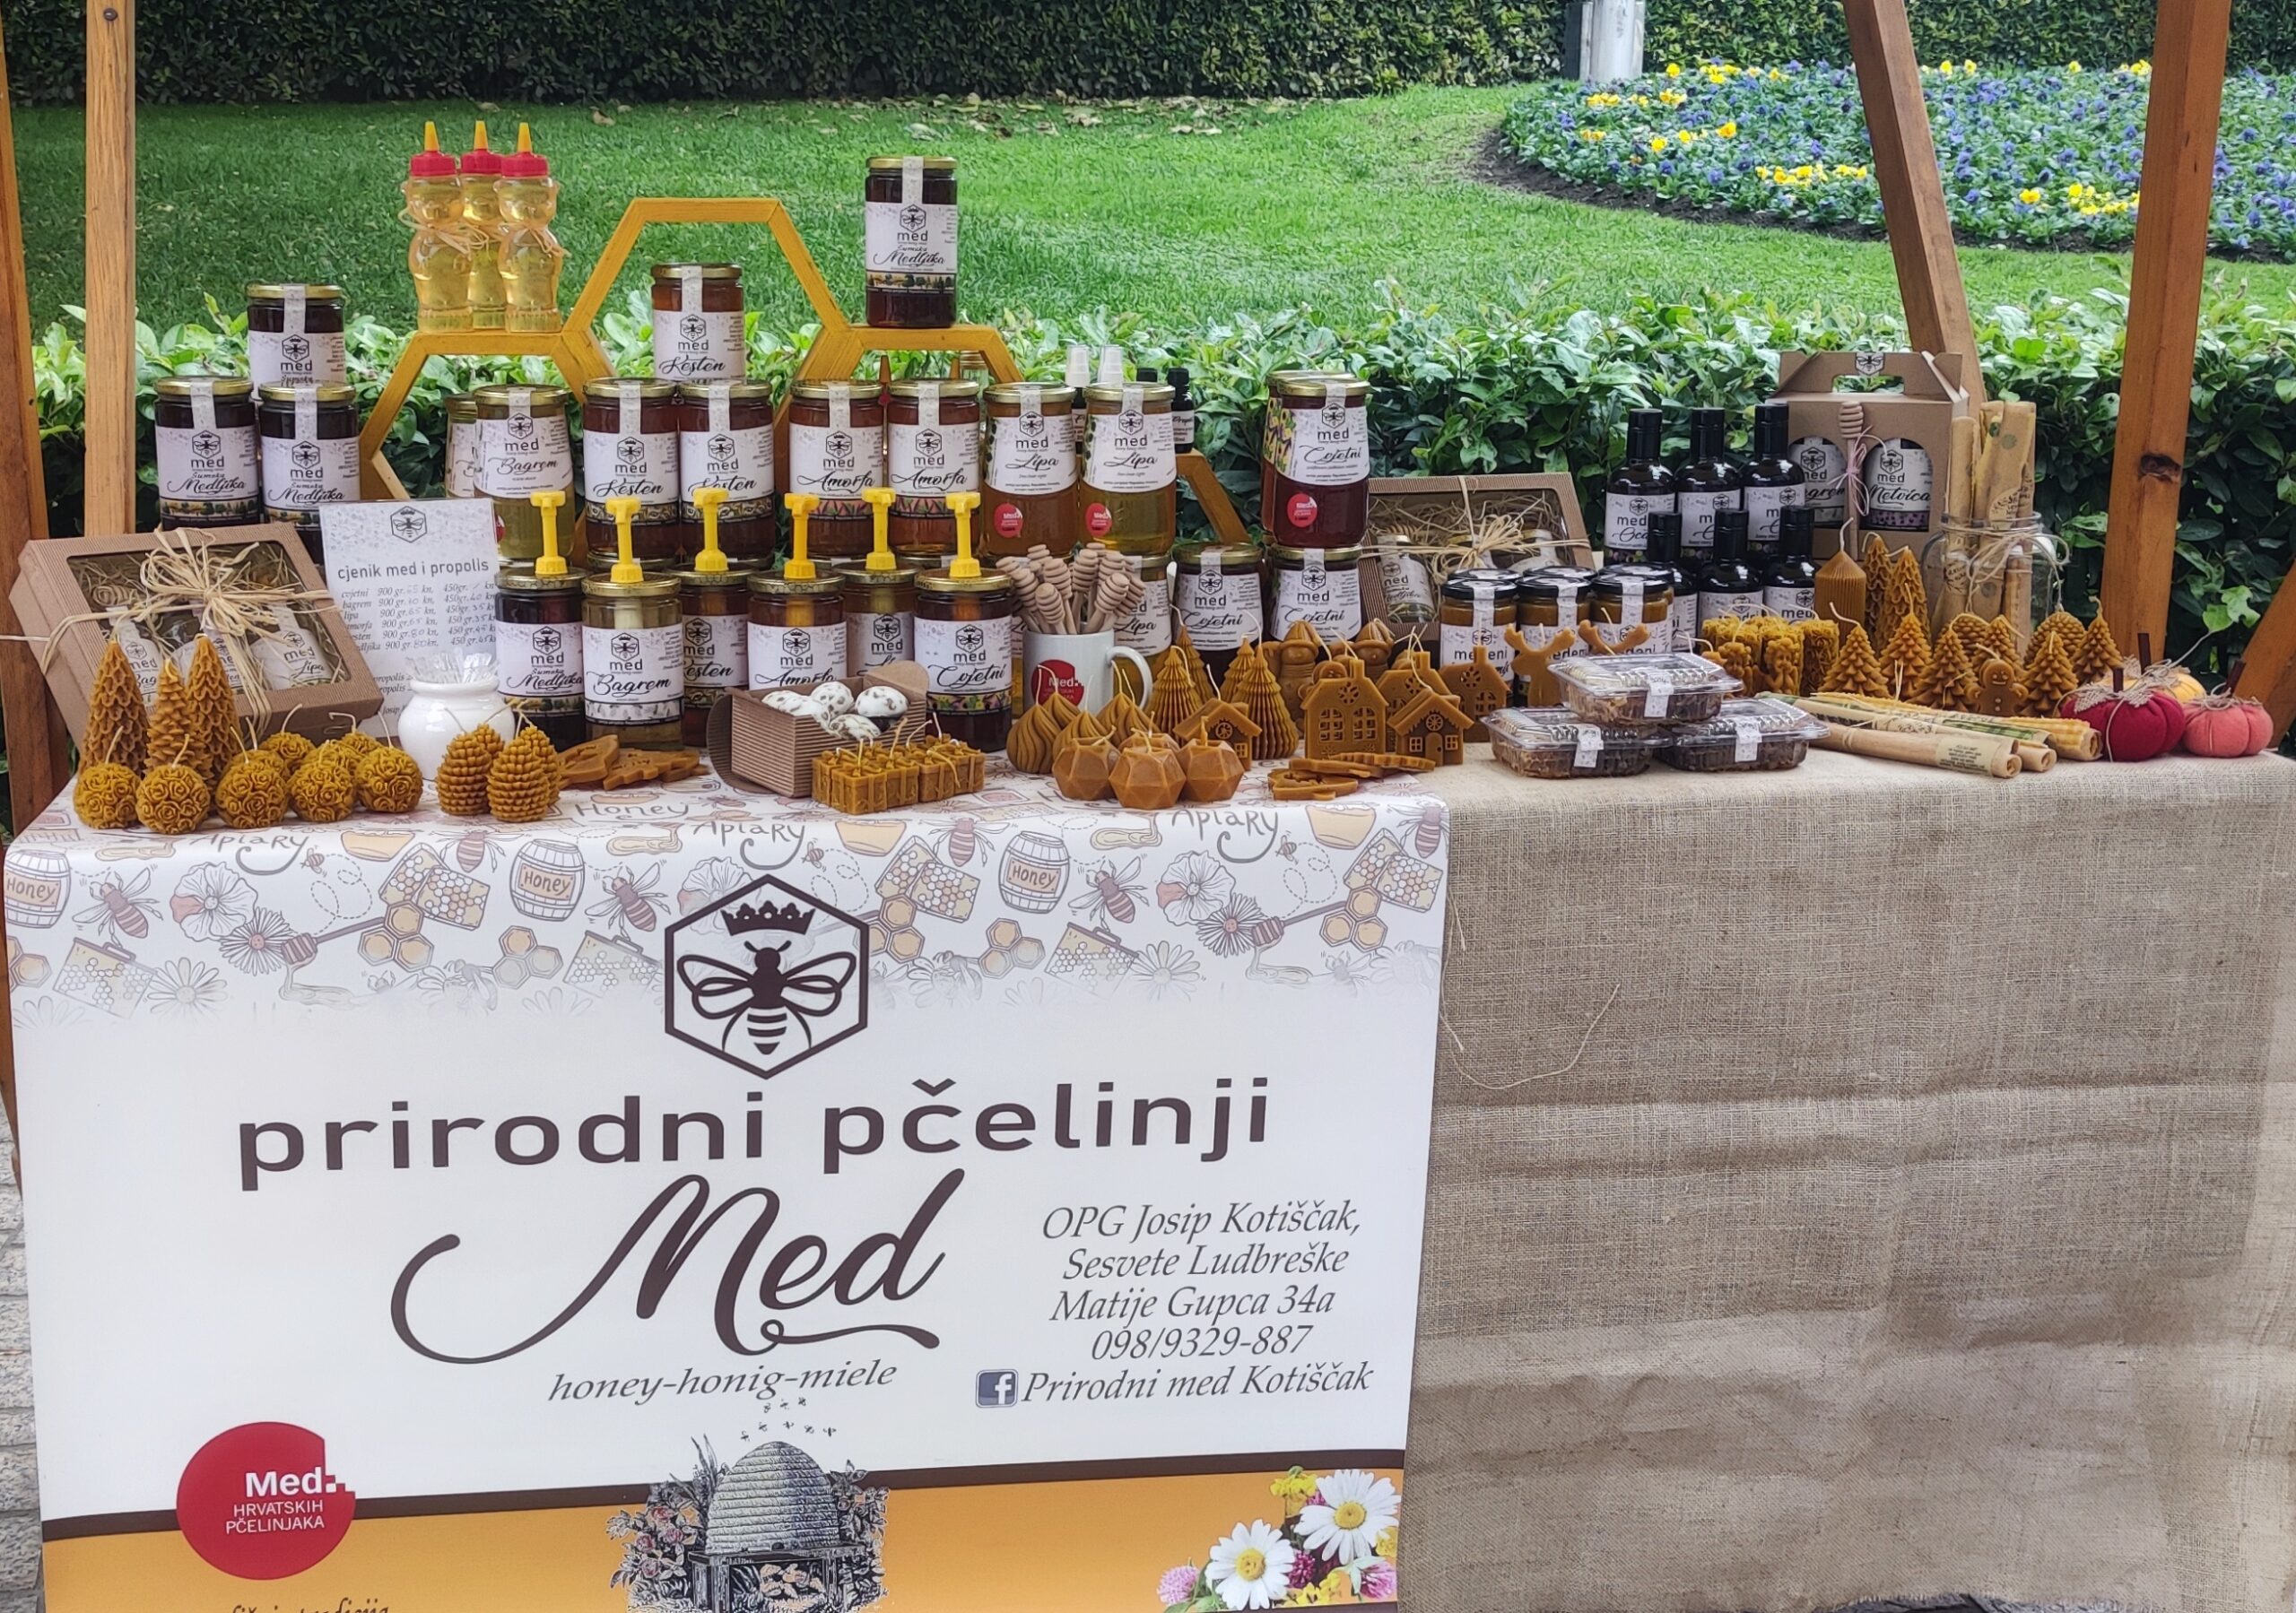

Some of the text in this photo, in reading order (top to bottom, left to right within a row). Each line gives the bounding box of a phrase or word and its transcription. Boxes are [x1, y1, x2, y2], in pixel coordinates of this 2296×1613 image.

[898, 230, 928, 242] med
[678, 340, 709, 351] med
[280, 360, 313, 372] med
[658, 355, 726, 377] Kesten
[1114, 435, 1148, 447] med
[1318, 429, 1350, 440] med
[505, 438, 539, 452] med
[1015, 437, 1049, 448] med
[191, 455, 224, 467] med
[488, 457, 559, 475] Bagrem
[707, 458, 739, 471] med
[822, 456, 855, 468] med
[913, 455, 945, 467] med
[1005, 453, 1059, 472] Lipa
[1104, 452, 1158, 471] Lipa
[291, 467, 323, 479] med
[614, 463, 648, 473] med
[1877, 472, 1905, 483] med
[593, 476, 664, 497] Kesten
[1617, 515, 1647, 526] med
[338, 559, 490, 582] cjenik med i propolis
[377, 586, 393, 596] 900
[1297, 590, 1330, 603] med
[378, 597, 395, 607] 900
[1194, 594, 1227, 606] med
[344, 611, 359, 622] lipa
[379, 608, 396, 618] 900
[381, 619, 397, 629] 900
[382, 629, 398, 639] 900
[385, 640, 401, 650] 900
[683, 644, 716, 656] med
[871, 639, 904, 653] med
[531, 652, 564, 664] med
[780, 654, 813, 666] med
[953, 649, 987, 663] med
[1453, 648, 1508, 661] meeni
[610, 658, 643, 672] med
[379, 683, 406, 696] ropolis
[587, 671, 672, 698] Bagrem
[575, 804, 689, 821] Honey
[524, 868, 572, 895] Honey
[1011, 861, 1057, 889] Honey
[6, 878, 57, 902] Honey
[239, 1077, 1268, 1192] prirodni pčelinji
[1042, 1199, 1361, 1244] OPG Josip Kotiščak,
[390, 1168, 965, 1365] Med
[1062, 1241, 1350, 1280] Sesvete Ludbreške
[1048, 1283, 1337, 1329] Matije Gupca 34a
[1091, 1323, 1314, 1360] 098/9329-887
[547, 1359, 898, 1407] honey-honig-miele
[1021, 1368, 1162, 1403] Prirodni
[1166, 1365, 1236, 1398] med
[1239, 1360, 1375, 1396] Kotiščak
[233, 1499, 324, 1518] HRVATSKIH
[225, 1515, 326, 1535] PČELINJAKA
